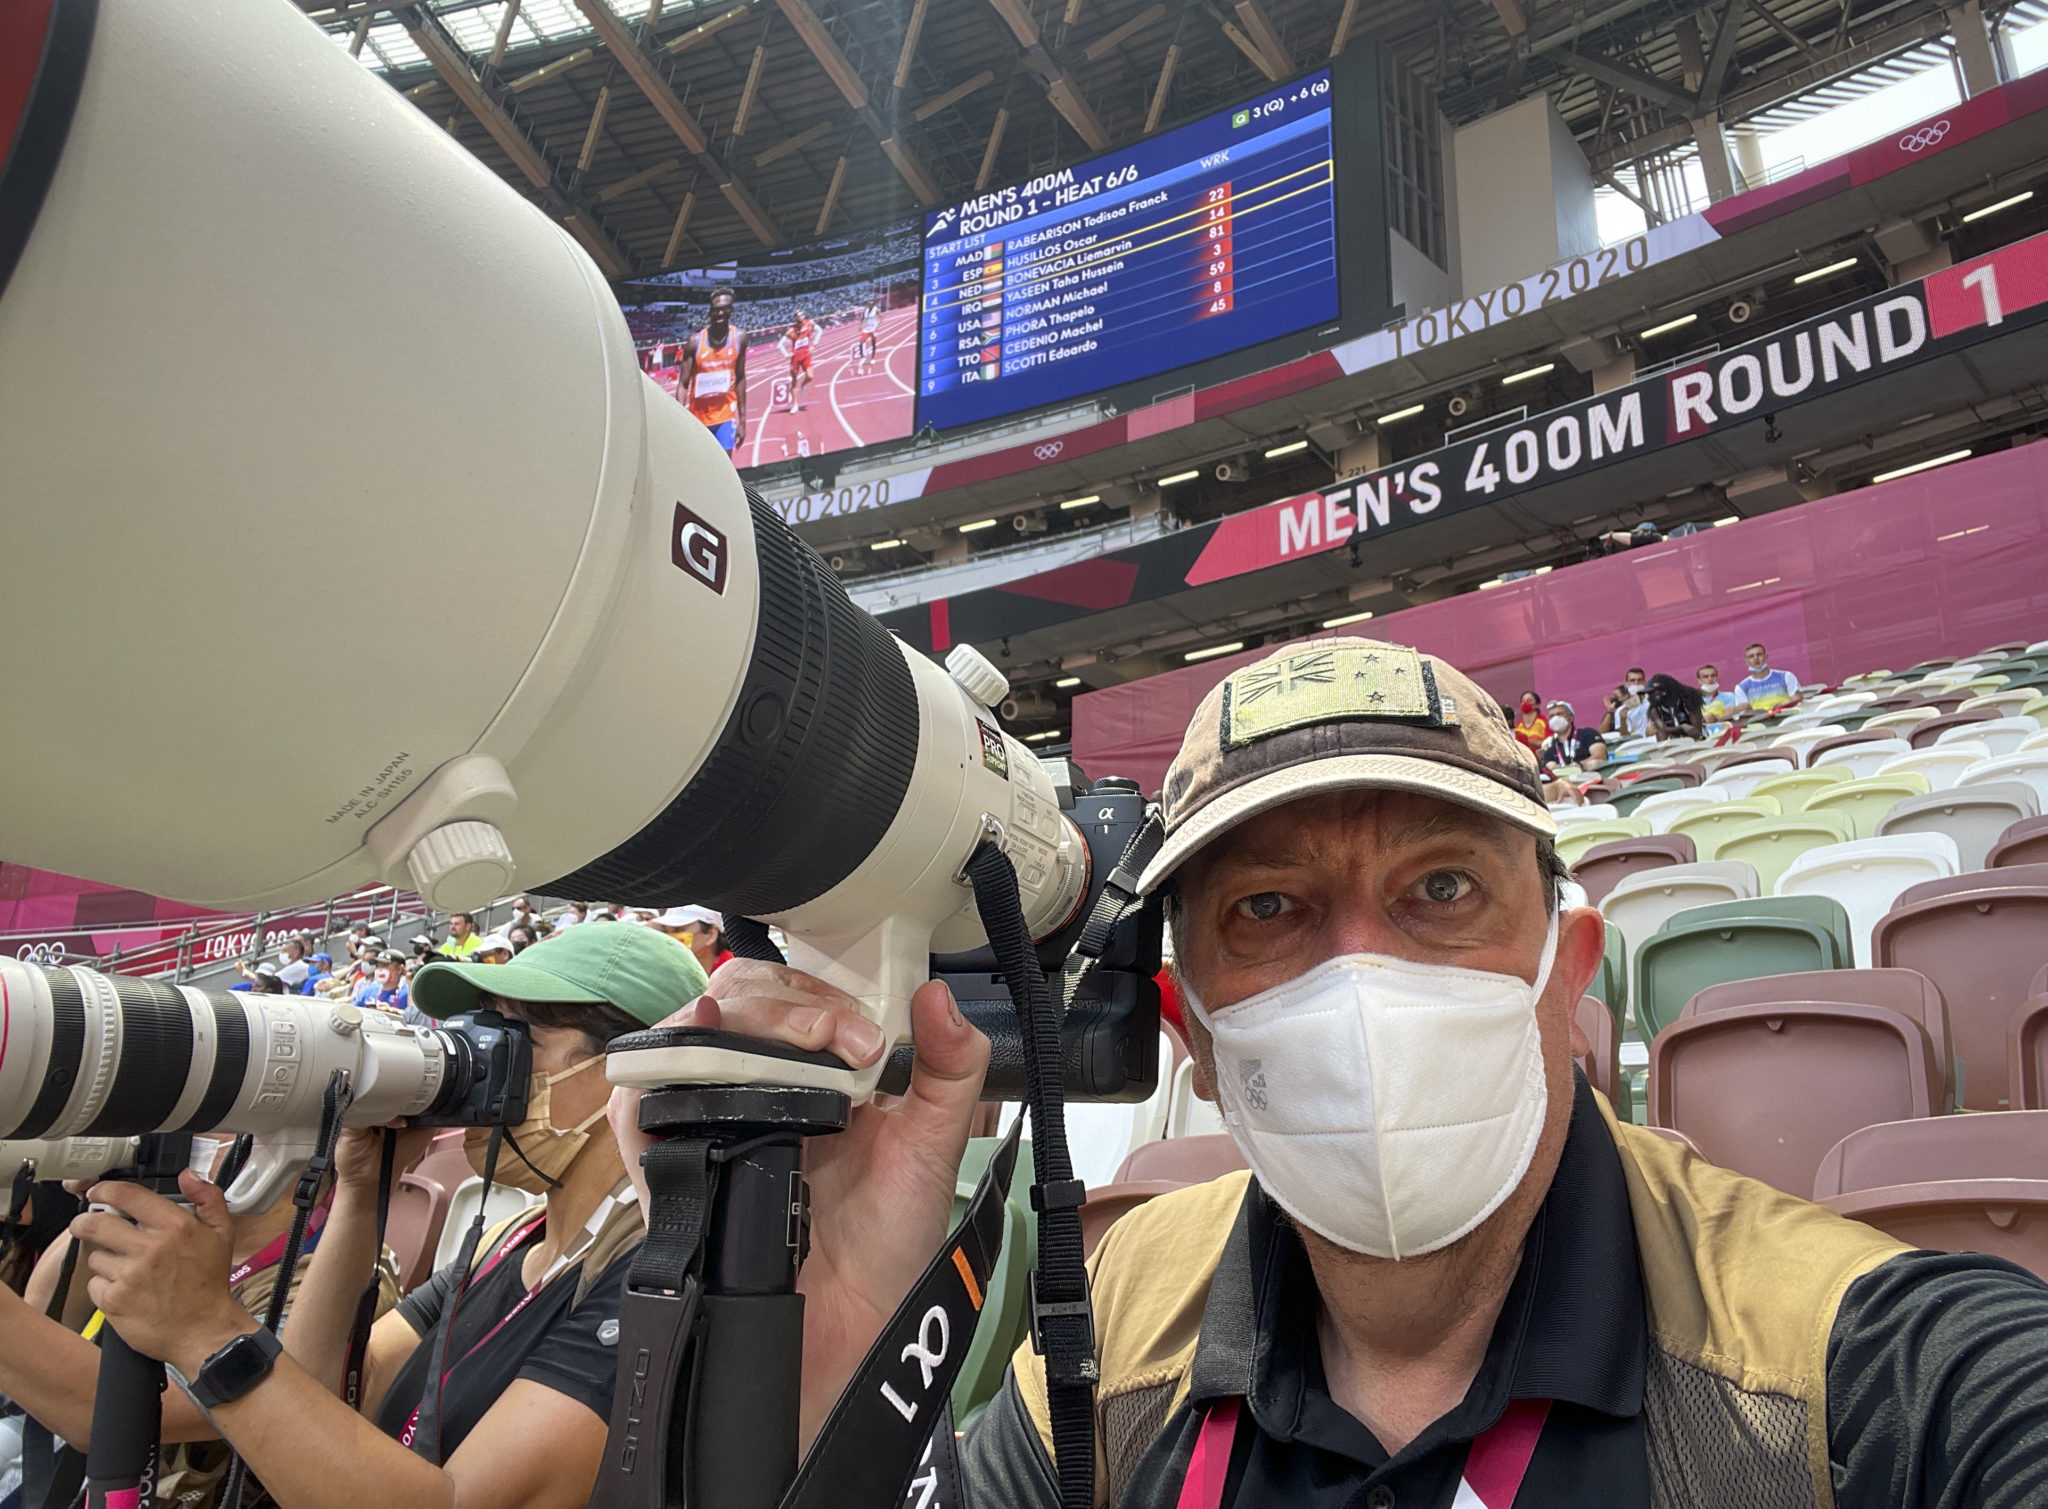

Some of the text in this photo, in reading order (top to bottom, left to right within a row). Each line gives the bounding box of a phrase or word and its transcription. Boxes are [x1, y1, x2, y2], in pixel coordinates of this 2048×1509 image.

[1252, 107, 1261, 118] 3
[1200, 150, 1230, 168] WRK
[959, 206, 1023, 236] ROUND
[1027, 200, 1039, 216] 1
[1055, 176, 1103, 206] HEAT
[1105, 164, 1139, 189] 6/6
[960, 168, 1074, 217] MEN'S 400M
[1209, 187, 1225, 202] 22
[1209, 207, 1225, 220] 14
[929, 234, 986, 259] START LIST
[932, 191, 1168, 273] 2 MAD RABEARISON Todisoa Franck
[1209, 225, 1224, 239] 81
[1213, 244, 1221, 256] 3
[931, 239, 1132, 306] 4 NED BONEVACIA Liemarvin
[932, 233, 1098, 290] 3 ESP HUSILLOS Oscar
[1209, 261, 1225, 276] 59
[929, 281, 1108, 340] 6 USA NORMAN Michael
[930, 260, 1124, 323] 5 IRQ YASEEN Taha Hussein
[1210, 298, 1226, 312] 45
[1213, 281, 1222, 293] 8
[1387, 235, 1649, 358] TOKYO 2020
[928, 319, 1103, 374] 8 TTO CEDENIO Machel
[929, 305, 1095, 357] 7 RSA PHORA Thapelo
[927, 340, 1098, 392] 9 ITA SCOTTI Edoardo
[775, 384, 786, 402] 3
[1279, 263, 2003, 556] MEN'S 400M ROUND 1
[1349, 465, 1366, 476] 221
[821, 479, 889, 519] 2020
[681, 521, 718, 583] G
[983, 733, 1005, 760] PRO
[325, 751, 410, 824] MADE IN JAPAN
[354, 768, 412, 820] ALC-SH155
[621, 1347, 651, 1475] GITZO
